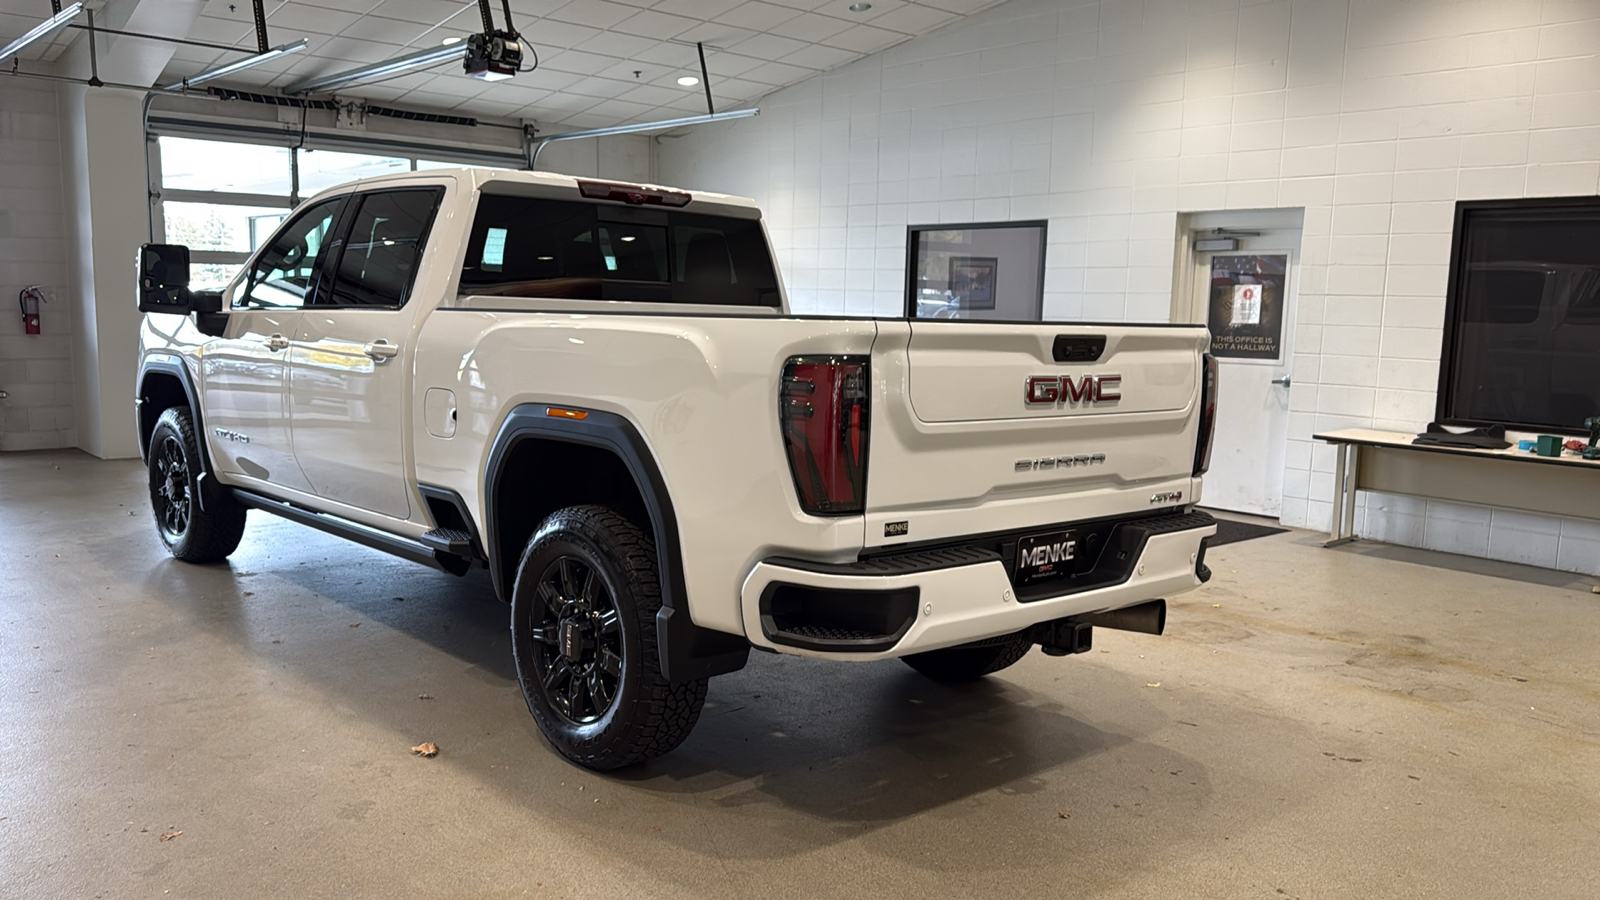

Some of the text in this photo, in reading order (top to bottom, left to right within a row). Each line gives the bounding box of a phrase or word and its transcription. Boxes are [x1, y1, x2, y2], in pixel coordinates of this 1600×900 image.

[1216, 335, 1273, 344] THIS OFFICE IS
[1212, 342, 1229, 350] NOT
[1237, 343, 1276, 352] HALLWAY
[1025, 374, 1121, 405] GMC
[1015, 453, 1106, 471] SIERRA
[885, 522, 908, 533] MENKE
[1021, 540, 1076, 568] MENKE
